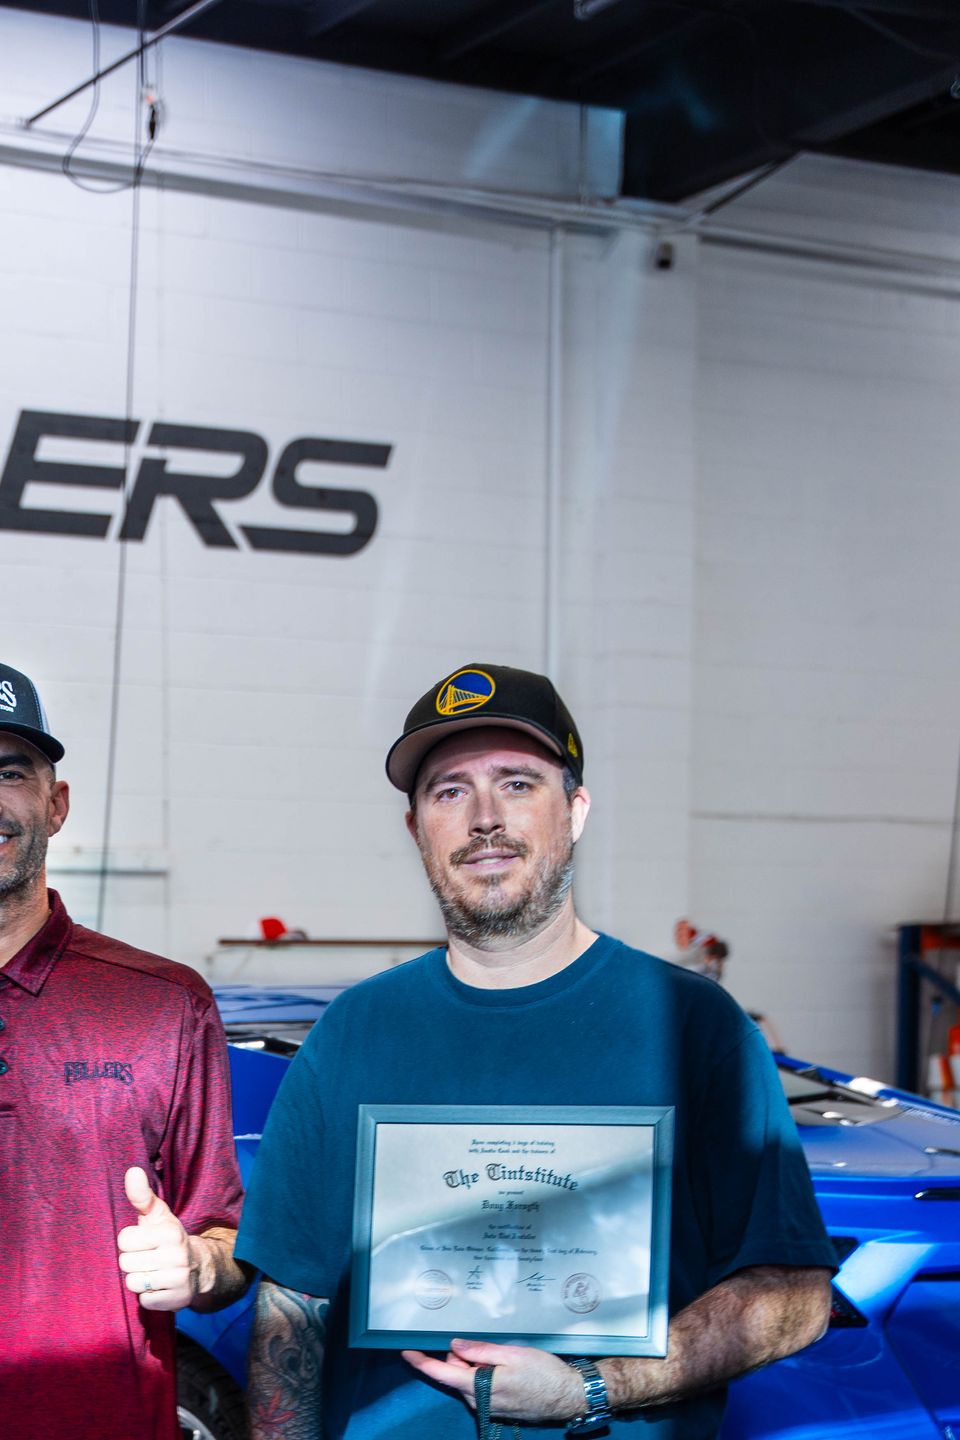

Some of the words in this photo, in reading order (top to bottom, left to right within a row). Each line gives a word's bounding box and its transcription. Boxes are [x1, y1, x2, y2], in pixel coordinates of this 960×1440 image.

[63, 1061, 135, 1086] FELLERS
[442, 1168, 480, 1190] The
[485, 1162, 579, 1192] Tintstitute
